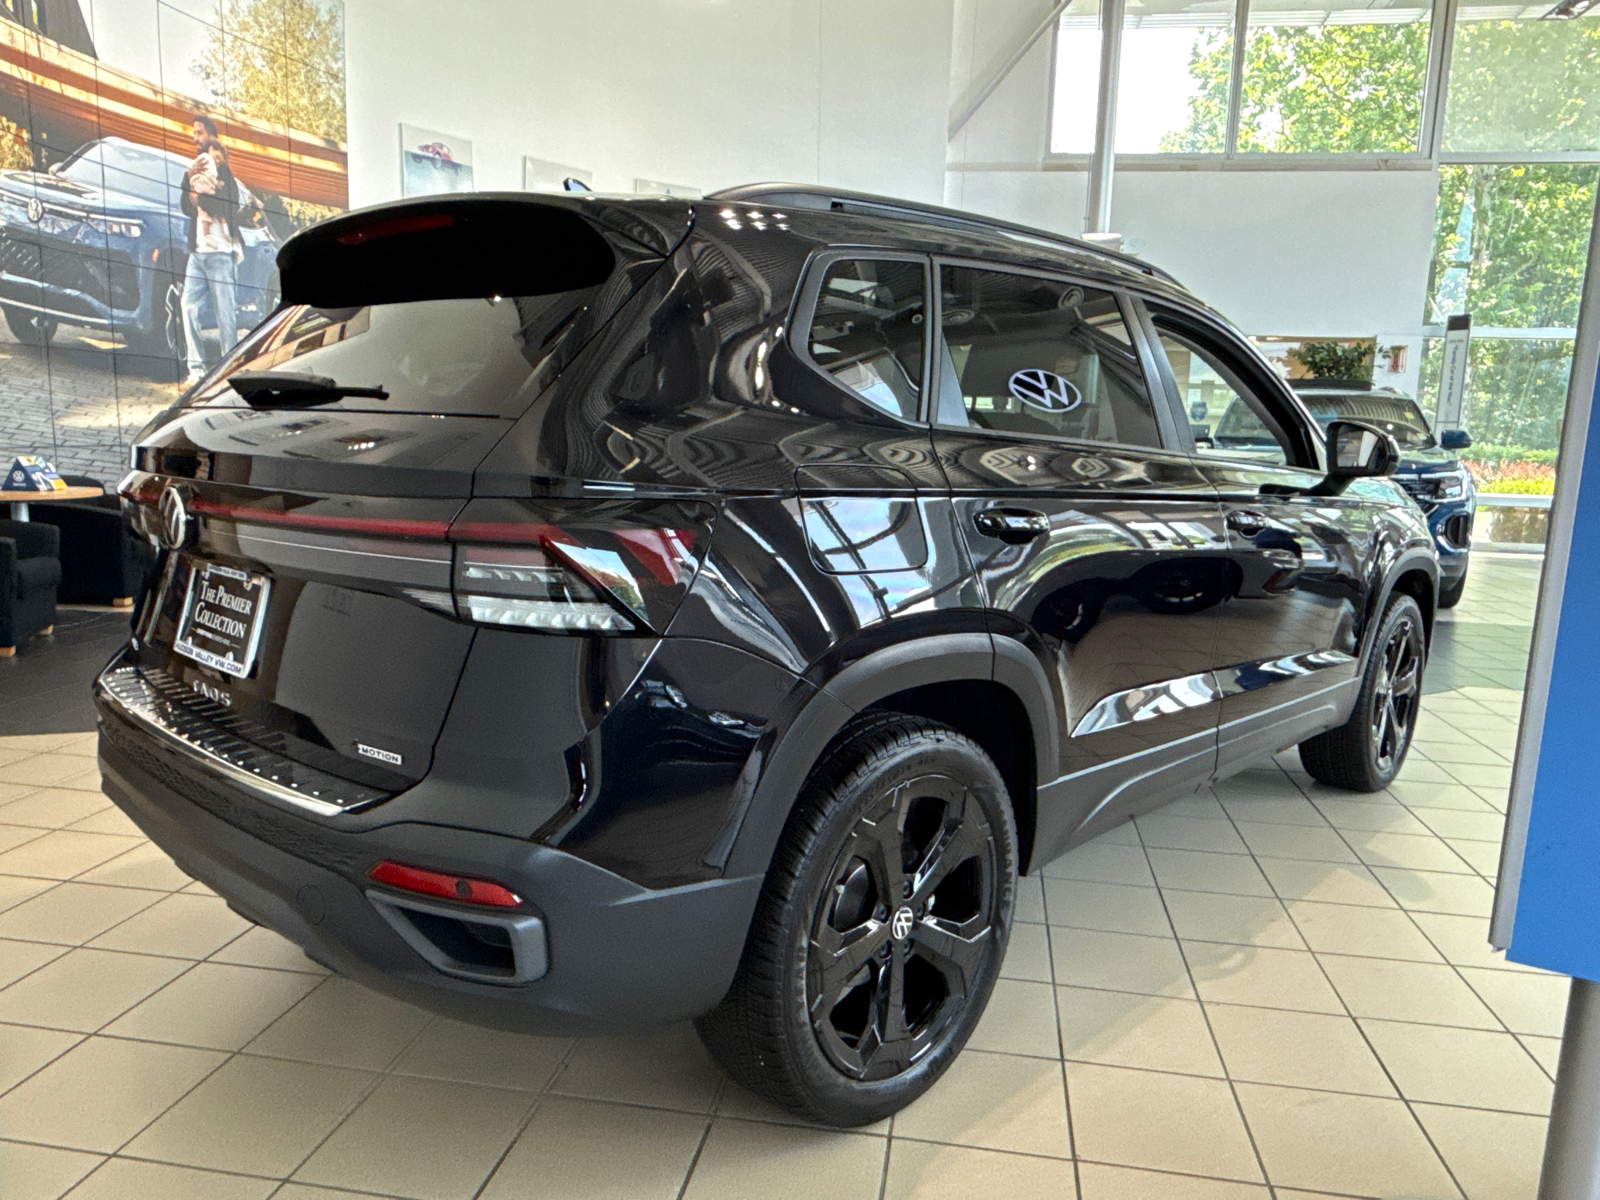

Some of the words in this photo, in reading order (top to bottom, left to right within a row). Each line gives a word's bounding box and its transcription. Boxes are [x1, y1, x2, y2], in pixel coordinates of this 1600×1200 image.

[201, 580, 216, 604] THE
[216, 585, 252, 615] PREMIER
[194, 602, 247, 638] COLLECTION
[195, 649, 214, 664] VALLEY
